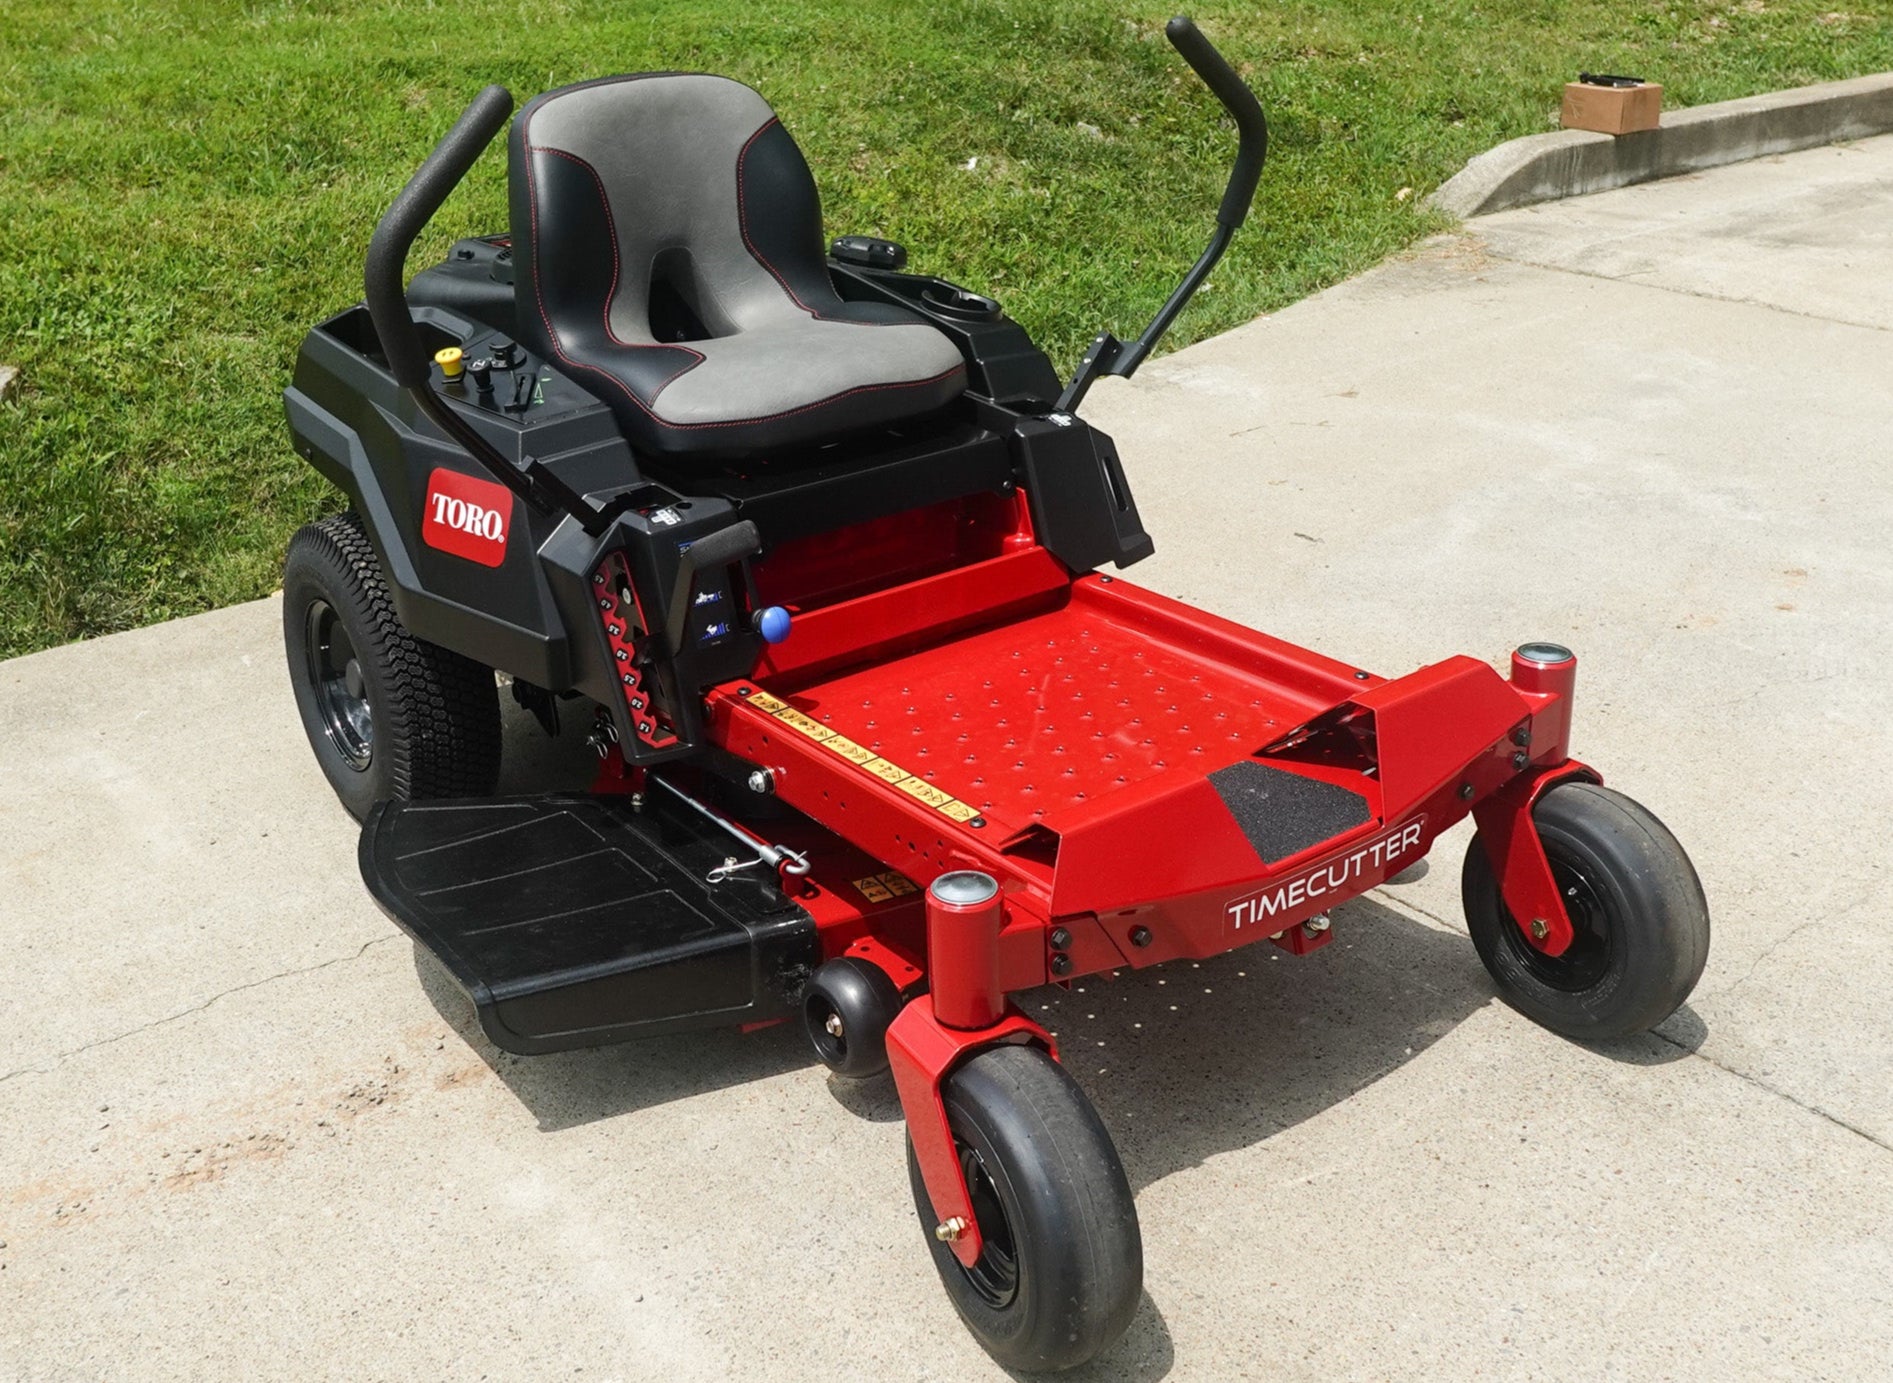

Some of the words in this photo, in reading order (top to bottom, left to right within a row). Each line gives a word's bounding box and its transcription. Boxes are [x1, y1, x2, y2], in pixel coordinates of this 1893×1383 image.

[631, 698, 643, 709] 2.0
[639, 722, 650, 733] 1.5
[1228, 823, 1423, 929] TIMECUTTER
